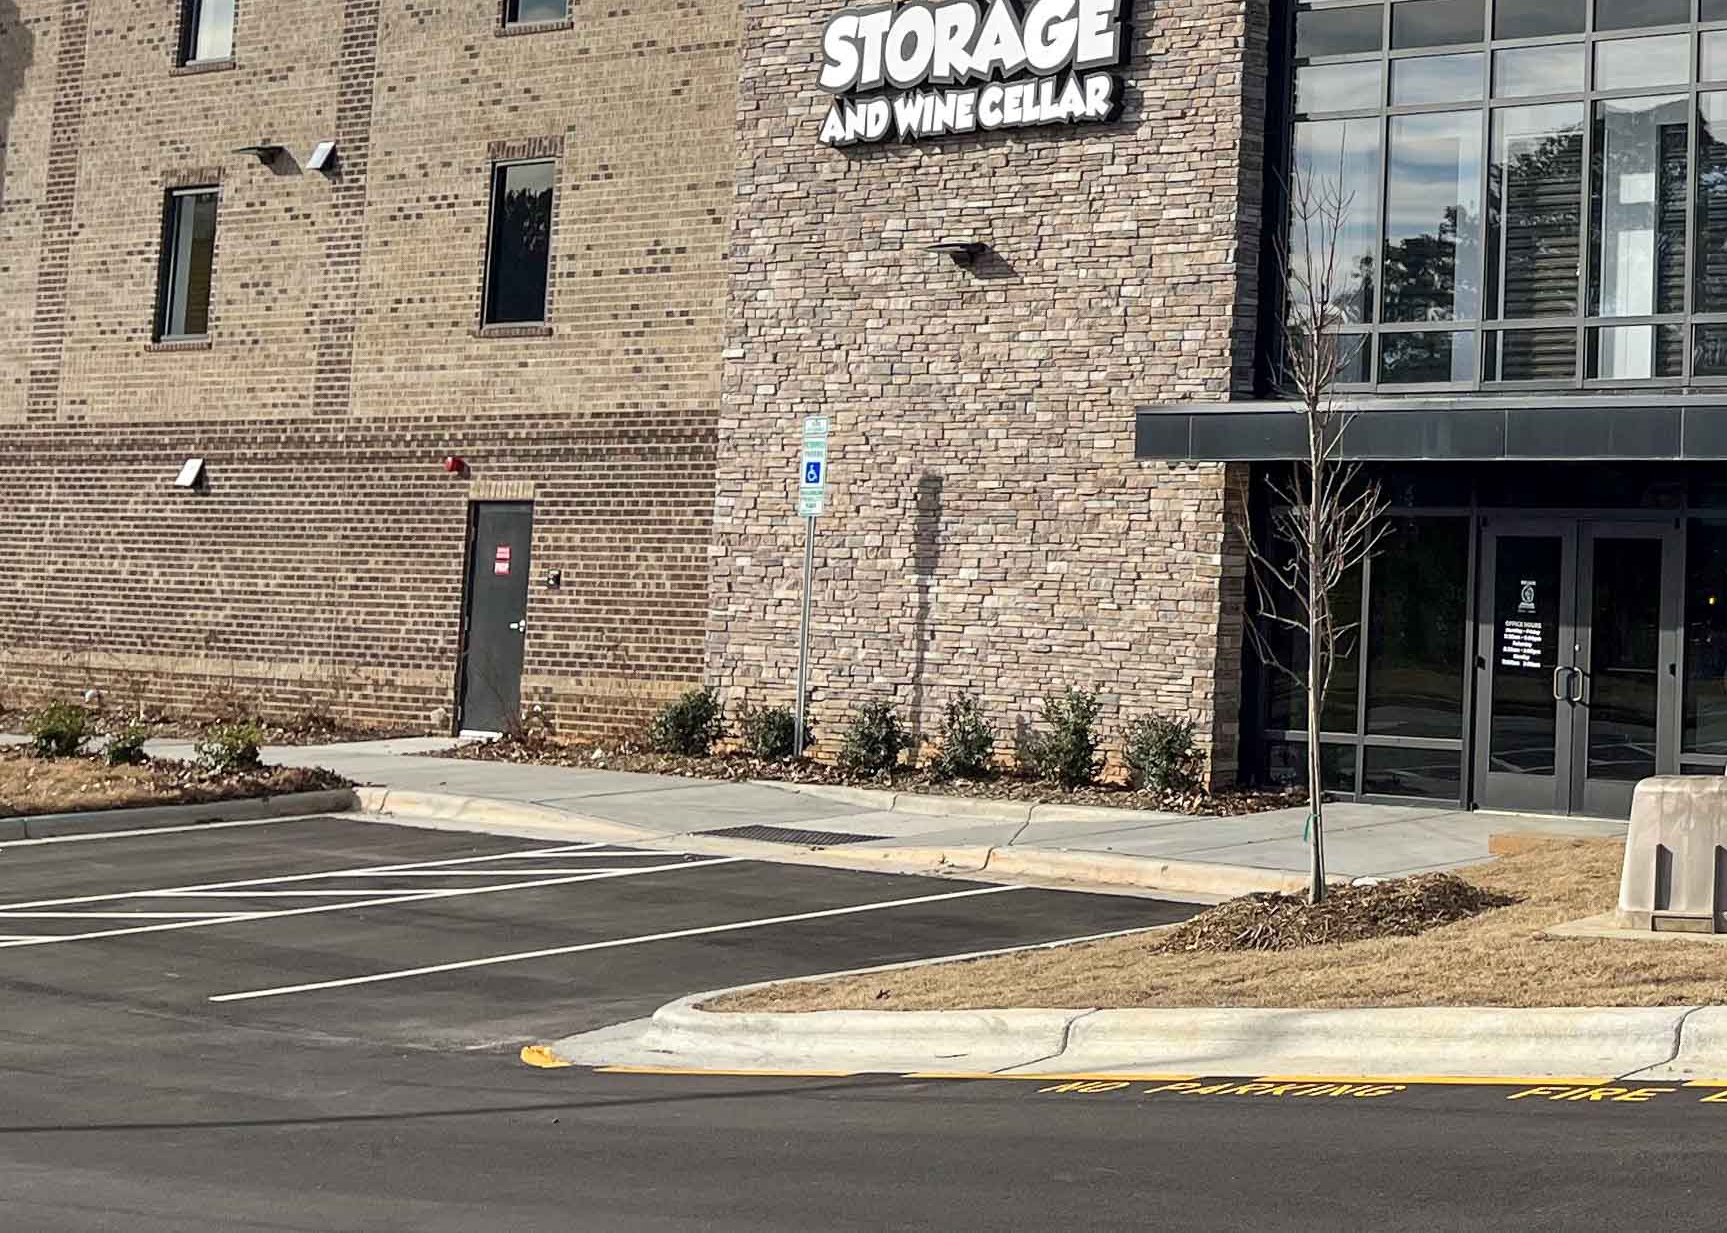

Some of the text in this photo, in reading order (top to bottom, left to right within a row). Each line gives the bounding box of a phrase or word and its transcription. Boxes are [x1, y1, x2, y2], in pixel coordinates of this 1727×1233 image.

[819, 70, 1113, 143] AND WINE CELLAR
[1036, 1081, 1131, 1094] NO
[1143, 1082, 1407, 1097] PARKING
[1506, 1086, 1677, 1102] FIRE
